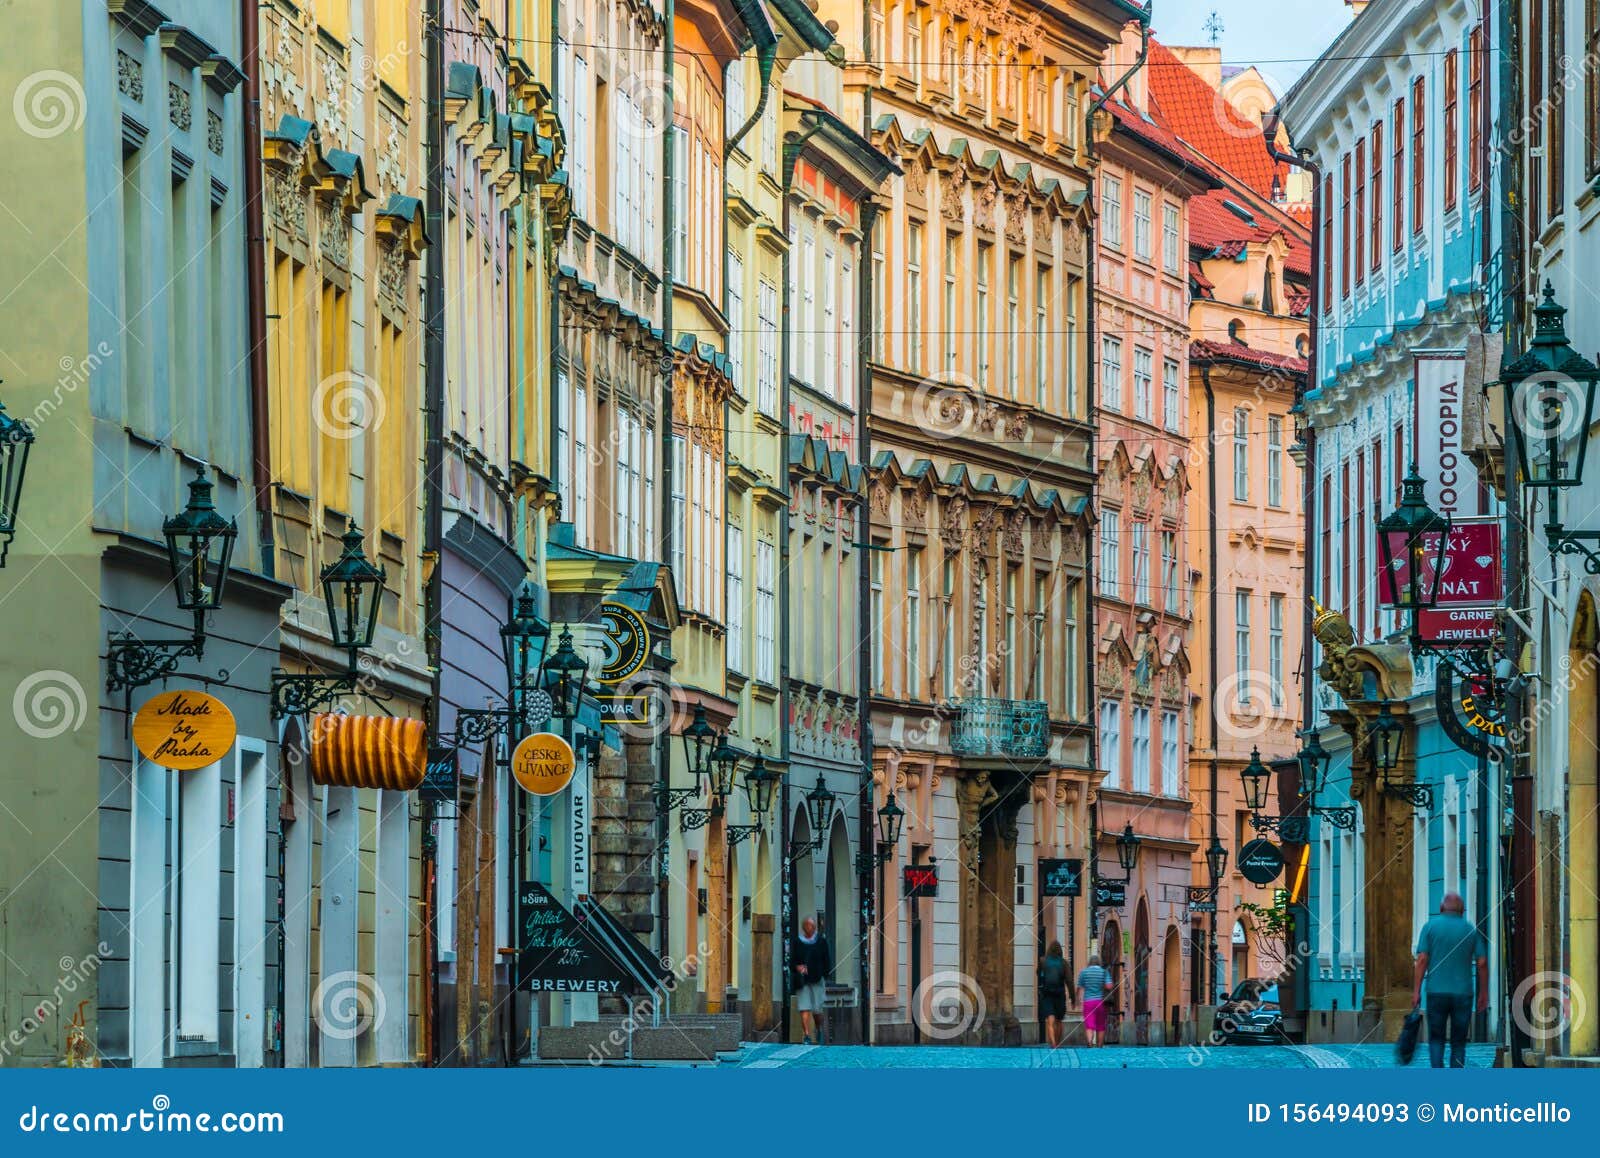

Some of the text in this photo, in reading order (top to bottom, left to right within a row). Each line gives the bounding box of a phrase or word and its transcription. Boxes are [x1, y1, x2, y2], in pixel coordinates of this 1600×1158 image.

[1440, 381, 1458, 516] HOCOTOPIA
[1423, 536, 1471, 552] ESKÝ
[1449, 610, 1494, 621] GARNE
[1436, 628, 1501, 640] JEWELLE
[157, 693, 212, 716] Made
[600, 704, 634, 714] OVAR
[173, 719, 198, 743] by
[153, 737, 212, 760] Praha
[574, 795, 585, 873] PIVOVAR
[531, 979, 620, 993] BREWERY
